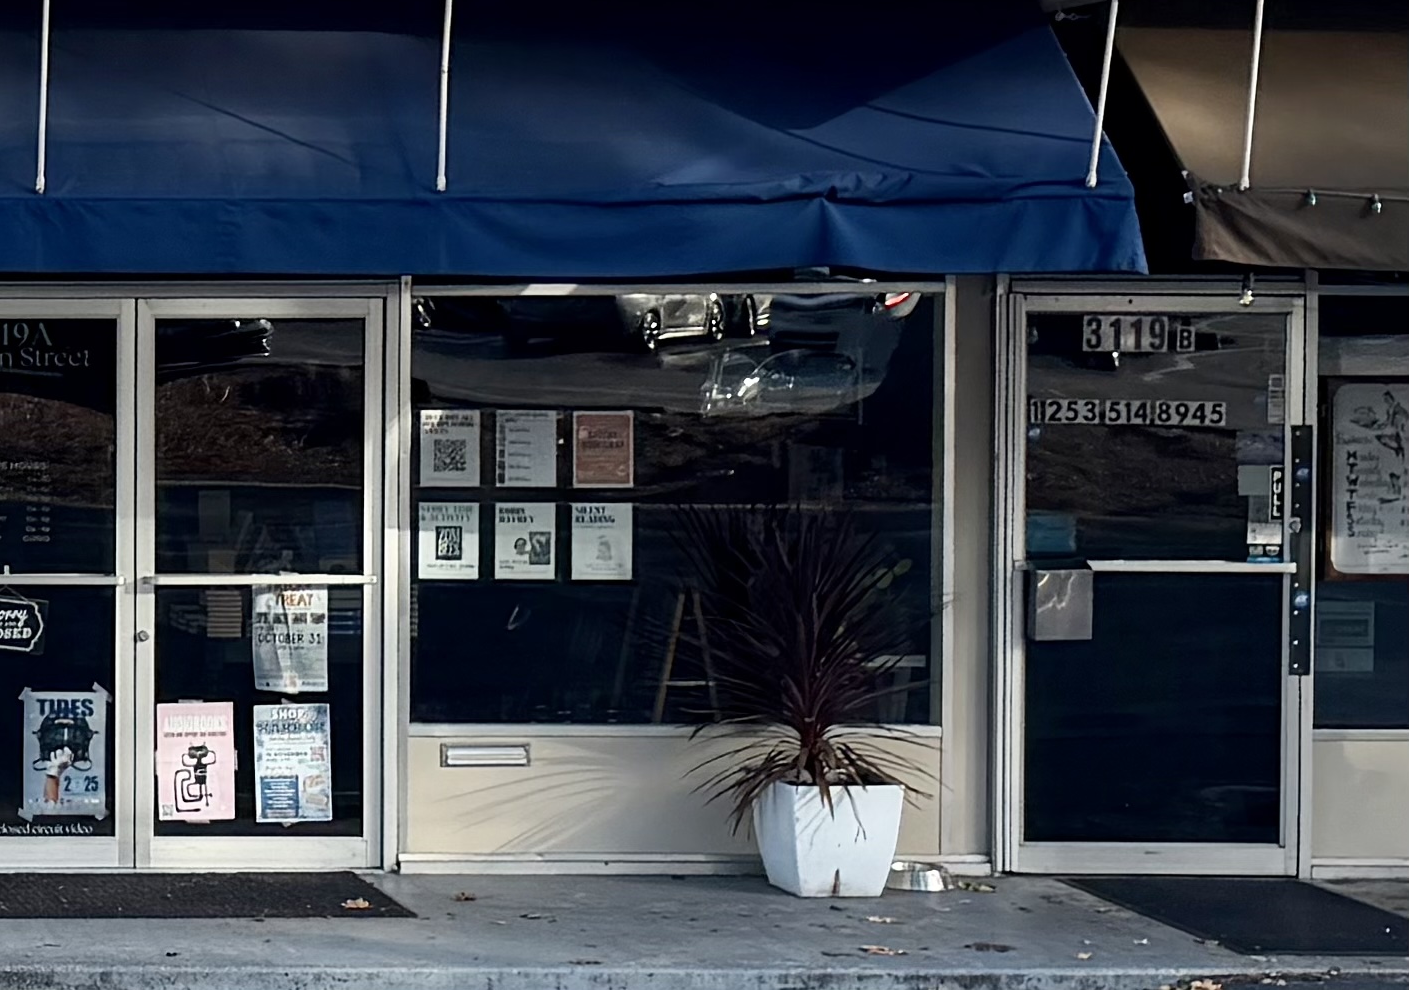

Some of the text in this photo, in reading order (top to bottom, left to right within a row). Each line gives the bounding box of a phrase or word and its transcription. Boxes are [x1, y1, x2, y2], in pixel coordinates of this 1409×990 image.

[1085, 317, 1192, 350] 3119 B
[20, 347, 89, 367] Street
[1157, 402, 1224, 424] 8945
[1272, 470, 1282, 517] PULL
[258, 632, 322, 644] OCTOBER 31
